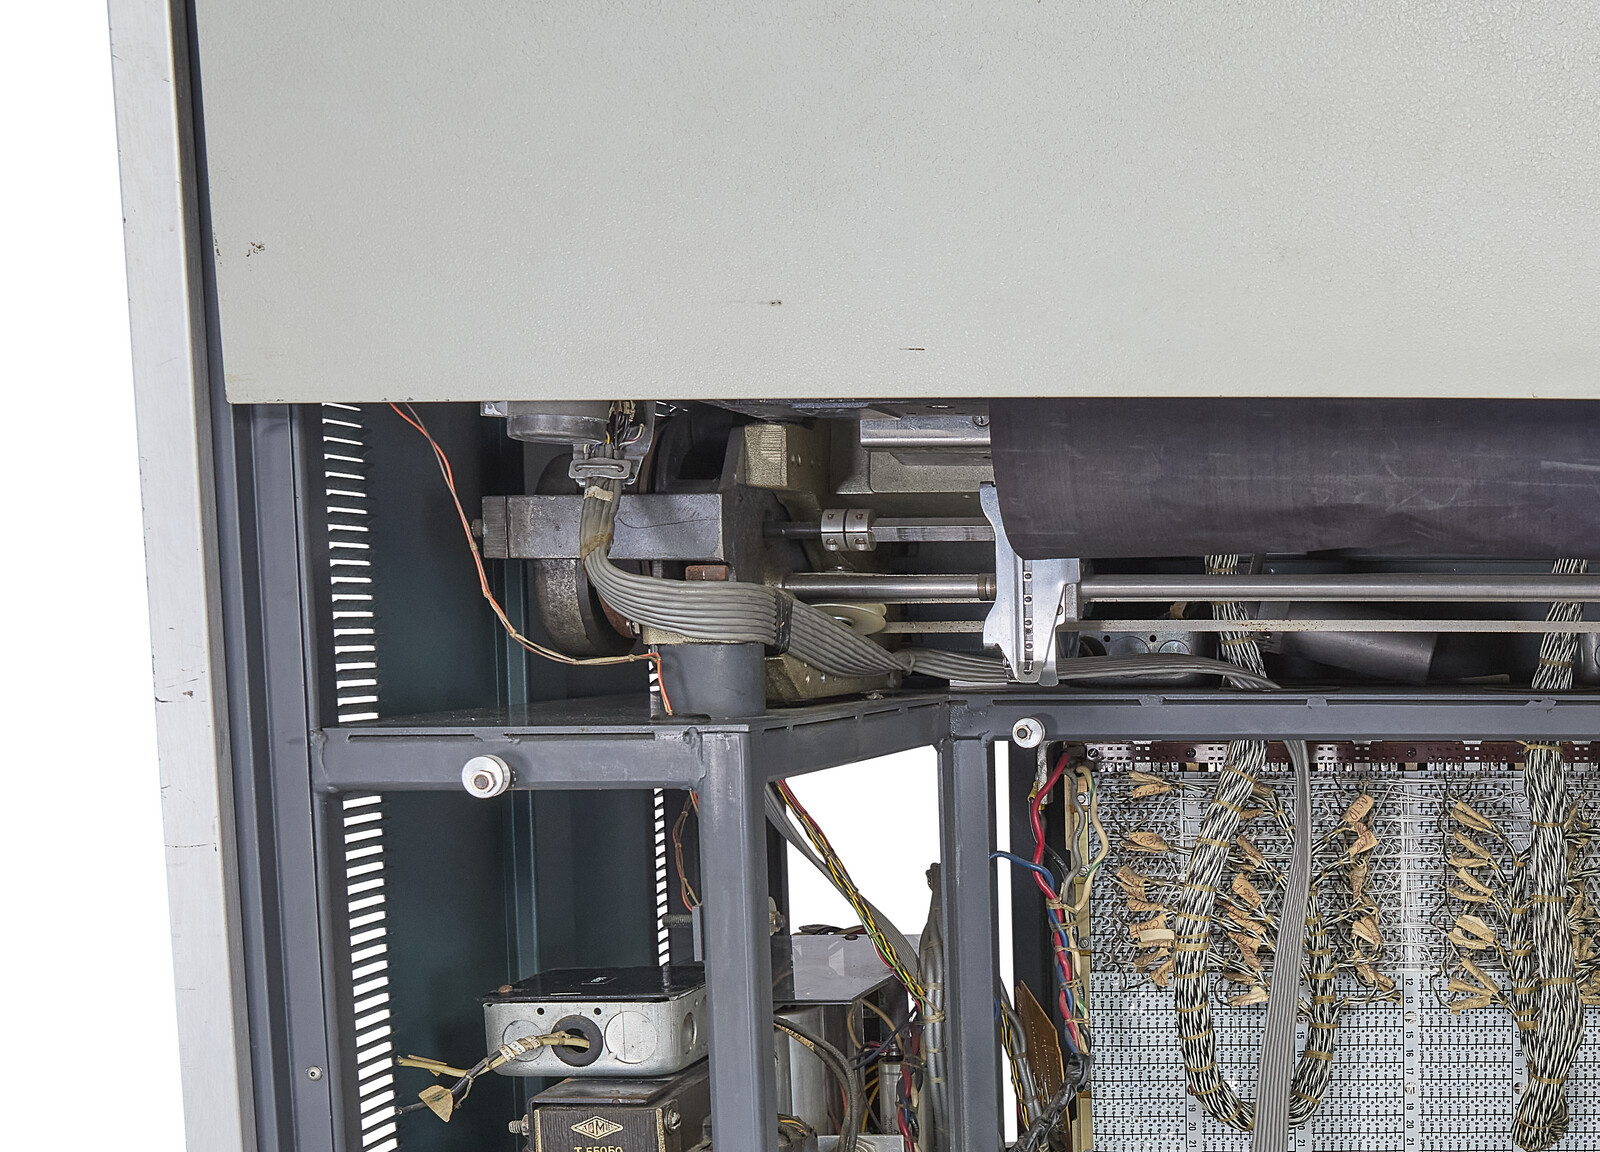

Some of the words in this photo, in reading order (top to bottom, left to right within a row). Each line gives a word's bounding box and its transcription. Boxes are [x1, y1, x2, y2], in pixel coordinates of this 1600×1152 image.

[1405, 978, 1413, 986] 12
[1405, 996, 1414, 1004] 13
[1296, 1031, 1305, 1039] 15
[1406, 1031, 1414, 1039] 15
[1406, 1049, 1414, 1057] 16
[1514, 1049, 1523, 1057] 16
[1406, 1067, 1414, 1075] 17
[1188, 1104, 1196, 1112] 19
[1406, 1102, 1414, 1110] 19
[1188, 1122, 1196, 1131] 20
[1406, 1120, 1414, 1129] 20
[1189, 1140, 1197, 1148] 21
[1297, 1139, 1306, 1147] 21
